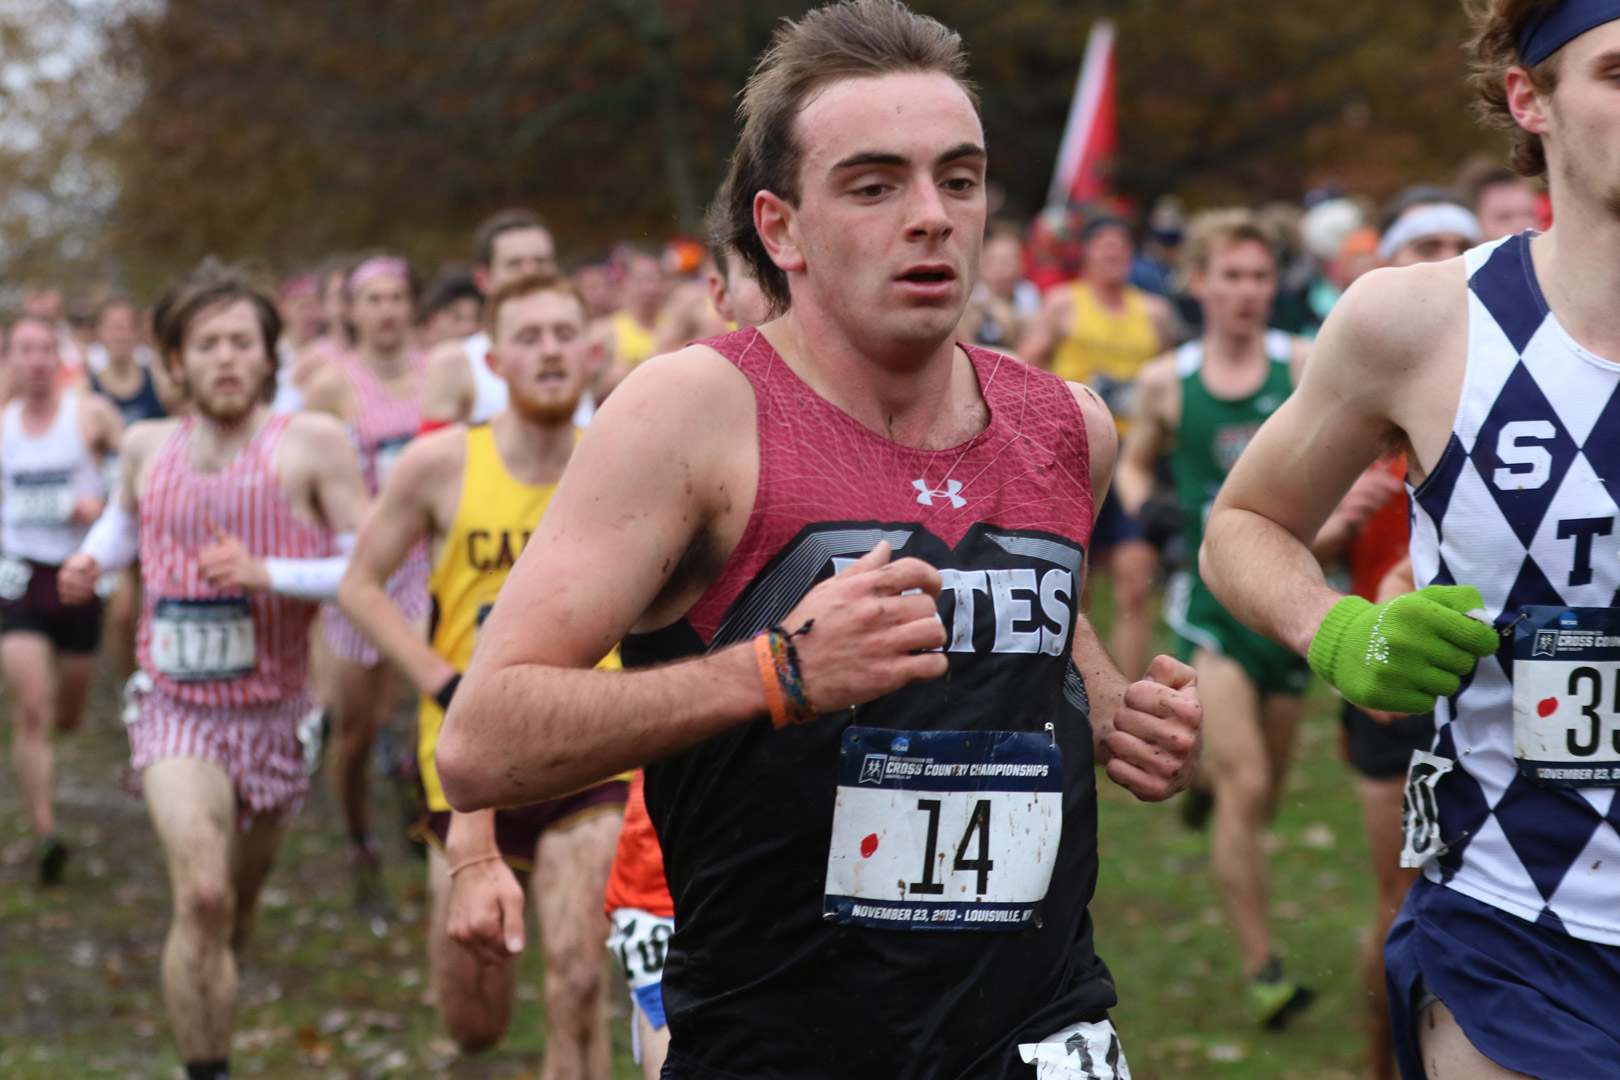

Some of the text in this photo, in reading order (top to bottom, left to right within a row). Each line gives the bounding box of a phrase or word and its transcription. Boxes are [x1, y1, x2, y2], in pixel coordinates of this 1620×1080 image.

[1493, 420, 1556, 491] S
[1556, 516, 1615, 587] T
[1566, 666, 1620, 757] 3
[886, 762, 922, 776] CROSS
[924, 764, 970, 777] COUNTRY
[969, 763, 1049, 777] CHAMPIONSHIPS
[909, 799, 994, 895] 14
[852, 904, 911, 921] NOVEMBER
